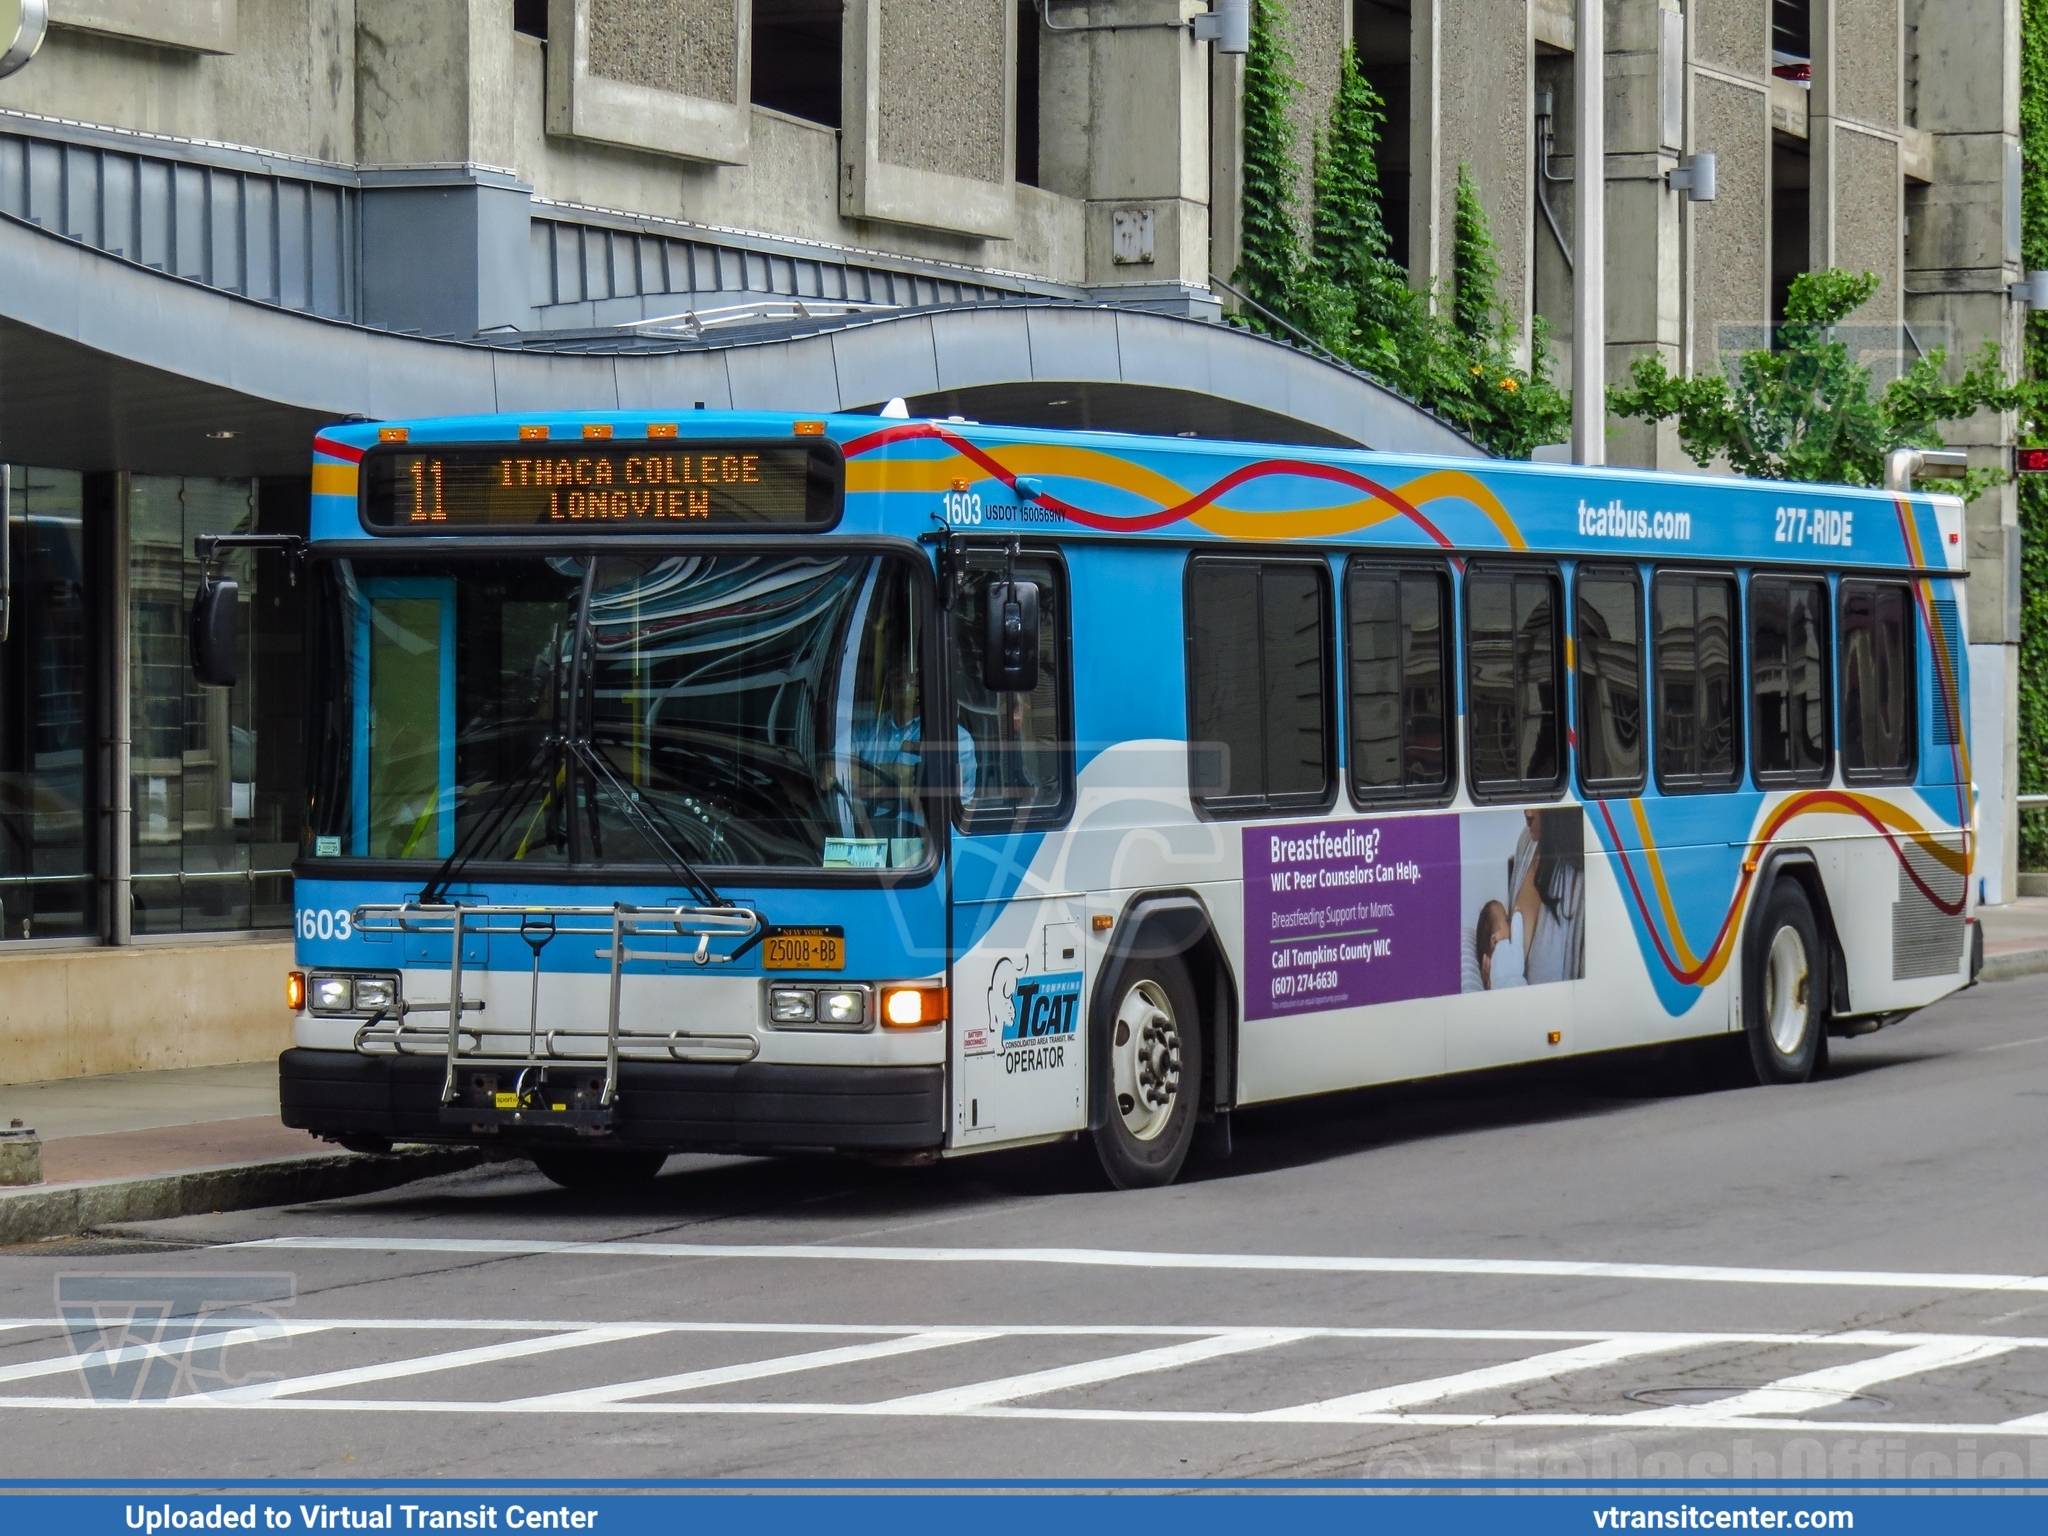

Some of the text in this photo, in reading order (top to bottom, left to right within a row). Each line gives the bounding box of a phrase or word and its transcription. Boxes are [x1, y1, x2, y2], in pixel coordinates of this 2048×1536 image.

[501, 455, 760, 487] ITHACA COLLEGE
[411, 460, 447, 521] 11
[550, 490, 710, 520] LONGVIEW
[943, 493, 982, 525] 1603
[985, 504, 1018, 521] USDOT
[1578, 499, 1691, 540] tcatbus.com
[1775, 506, 1853, 546] 277-RIDE
[1270, 828, 1380, 864] Breastfeeding?
[1271, 860, 1421, 892] WIC Peer Counselors Can Help.
[295, 908, 352, 940] 1603
[1272, 902, 1395, 929] Breastfeeding Support for Moms.
[804, 928, 824, 936] YORK
[1272, 939, 1391, 969] Call Tompkins County WIC
[1041, 981, 1080, 993] TOMPKINS
[1271, 970, 1338, 998] (607) 274-6630
[1017, 984, 1078, 1038] TCAT
[1005, 1039, 1036, 1049] CONSOLIDATED
[1037, 1037, 1048, 1045] AREA
[1006, 1046, 1065, 1075] OPERATOR
